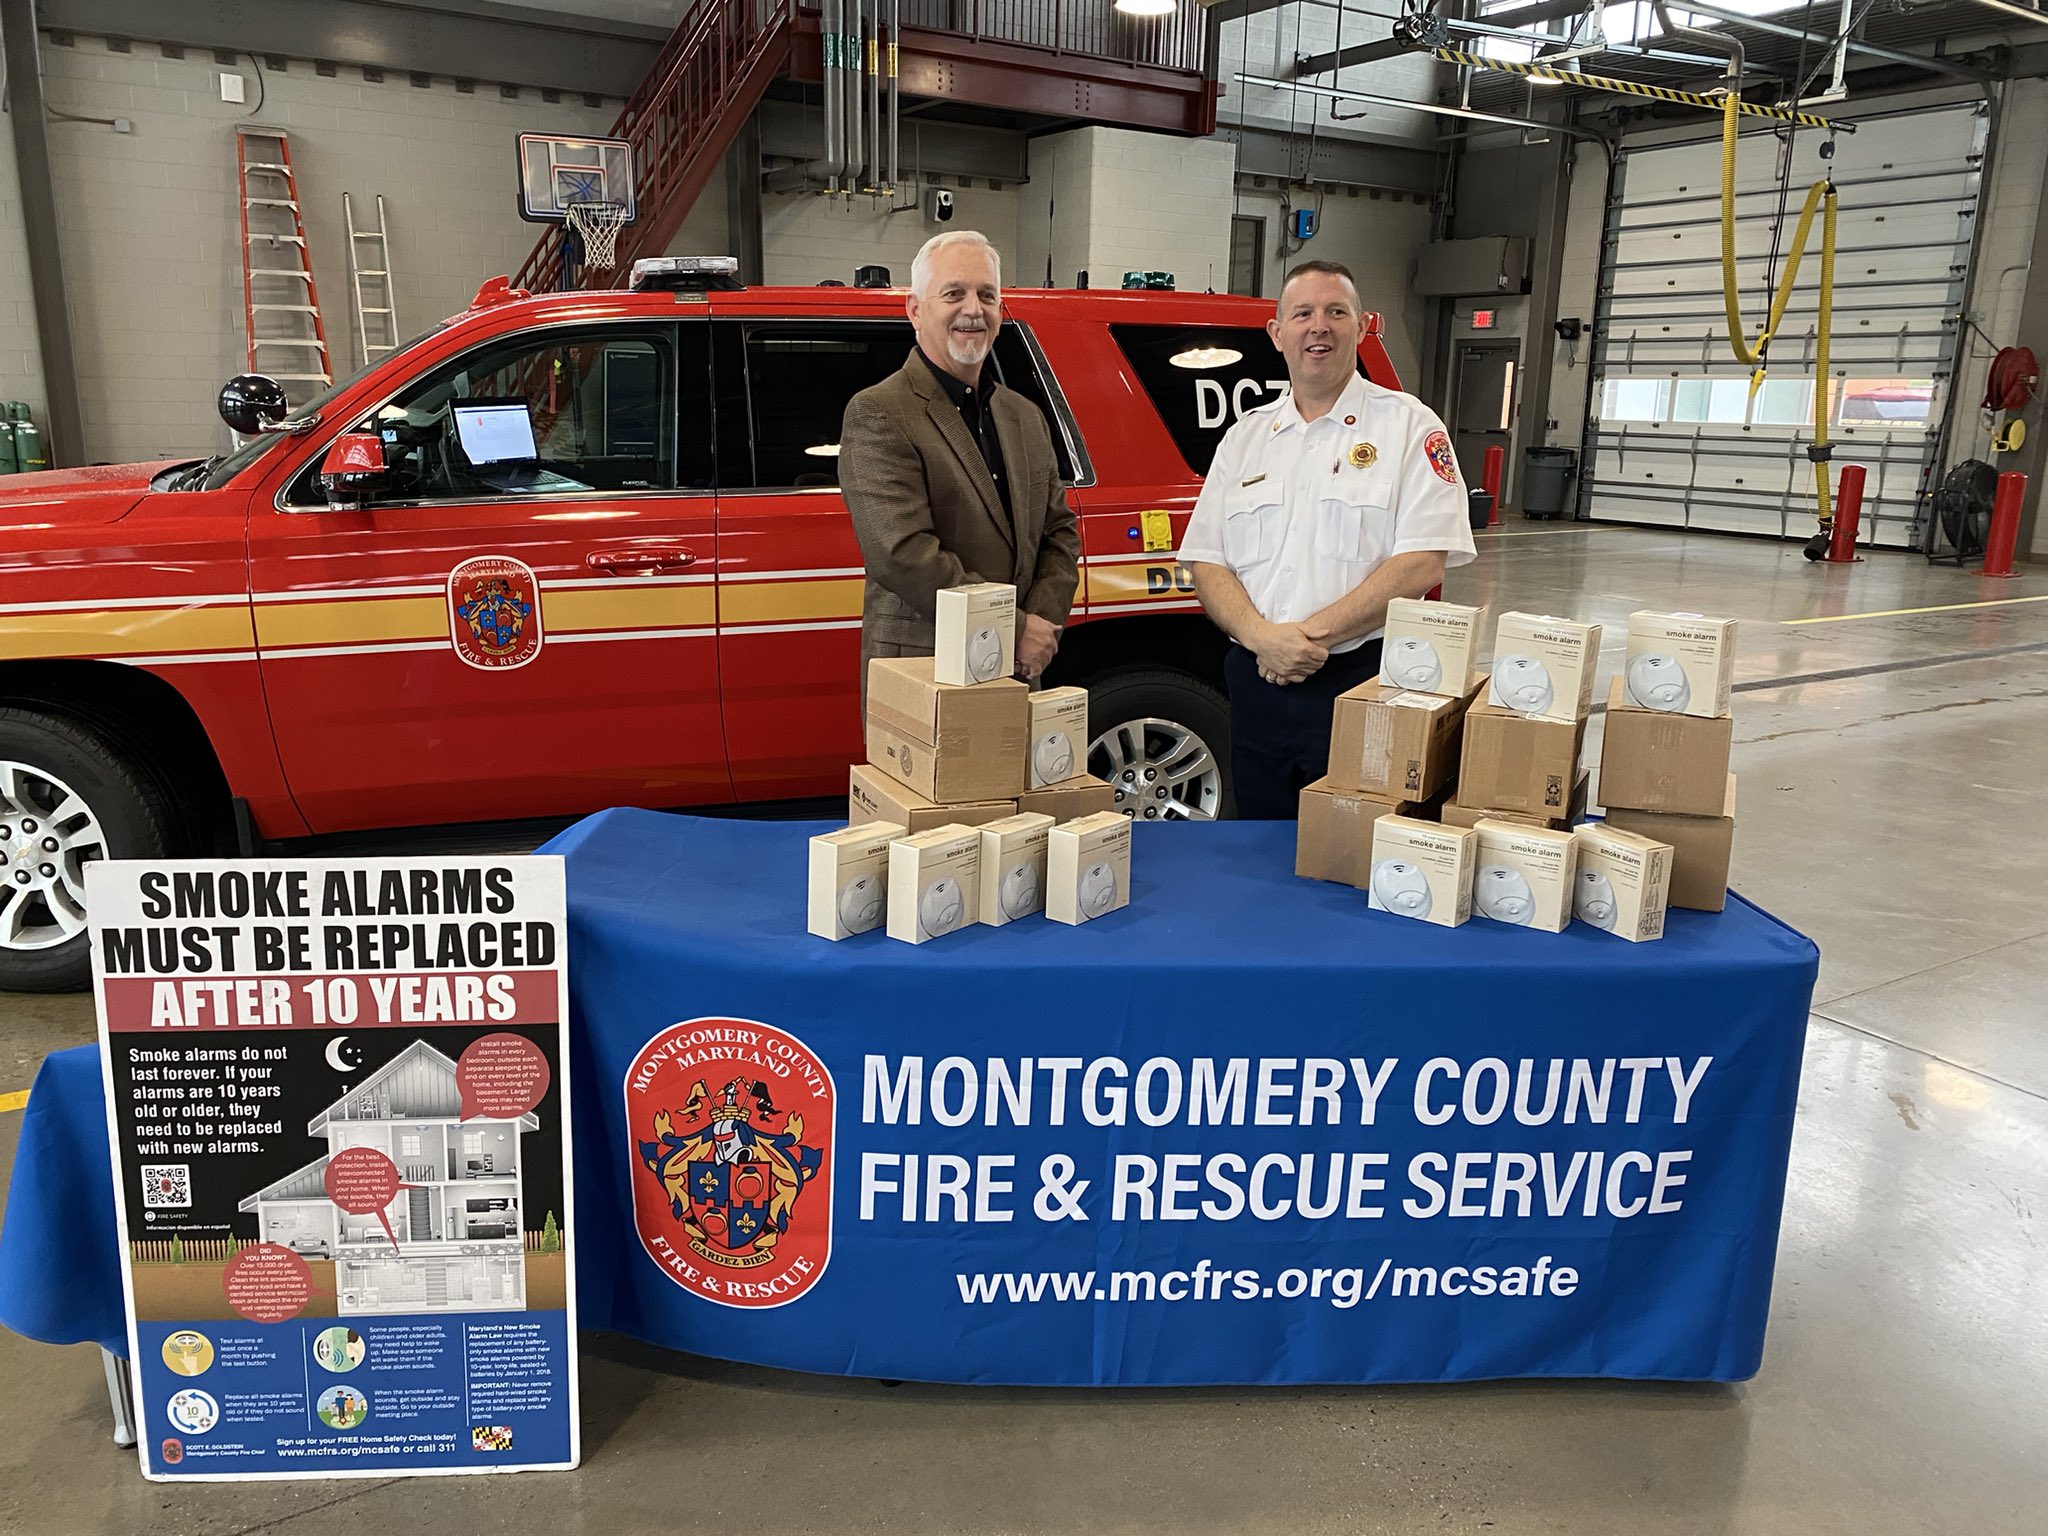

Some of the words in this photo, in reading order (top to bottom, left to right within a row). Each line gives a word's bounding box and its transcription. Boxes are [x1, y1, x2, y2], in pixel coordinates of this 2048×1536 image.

[453, 561, 502, 587] MONTGOMERY
[504, 562, 531, 584] COUNTY
[468, 569, 515, 580] MARYLAND
[1560, 637, 1581, 645] alarm
[459, 642, 481, 663] FIRE
[485, 658, 494, 666] &
[500, 639, 537, 665] RESCUE
[1057, 706, 1072, 714] smoke
[1103, 835, 1117, 843] smoke
[1409, 839, 1433, 847] smoke
[1435, 844, 1456, 852] alarm
[868, 846, 886, 855] smoke
[947, 849, 963, 858] smoke
[965, 844, 978, 853] alarm
[1511, 845, 1537, 854] smoke
[1539, 850, 1561, 858] alarm
[1600, 848, 1621, 859] smoke
[1622, 856, 1640, 865] alarm
[139, 871, 310, 920] SMOKE
[321, 868, 514, 916] ALARMS
[101, 927, 240, 973] MUST
[254, 926, 311, 970] BE
[323, 921, 555, 970] REPLACED
[151, 980, 293, 1027] AFTER
[303, 978, 357, 1024] 10
[368, 975, 516, 1022] YEARS
[129, 1048, 180, 1062] Smoke
[185, 1047, 236, 1061] alarms
[242, 1047, 259, 1060] do
[264, 1047, 287, 1060] not
[633, 1028, 763, 1094] MONTGOMERY
[766, 1039, 828, 1100] COUNTY
[676, 1046, 791, 1079] MARYLAND
[132, 1067, 159, 1080] last
[163, 1066, 220, 1080] forever.
[225, 1066, 235, 1079] If
[240, 1067, 272, 1081] your
[133, 1086, 184, 1099] alarms
[189, 1088, 213, 1098] are
[218, 1085, 236, 1097] 10
[241, 1085, 280, 1099] years
[862, 1054, 1399, 1127] MONTGOMERY
[1413, 1056, 1713, 1126] COUNTY
[135, 1104, 157, 1117] old
[162, 1106, 177, 1117] or
[182, 1103, 224, 1118] older,
[229, 1103, 261, 1118] they
[137, 1123, 171, 1136] need
[177, 1124, 190, 1135] to
[196, 1122, 213, 1135] be
[218, 1120, 282, 1135] replaced
[138, 1141, 168, 1154] with
[174, 1143, 203, 1154] new
[208, 1140, 264, 1153] alarms.
[859, 1152, 1015, 1223] FIRE
[1033, 1154, 1090, 1221] &
[1111, 1152, 1389, 1221] RESCUE
[1401, 1150, 1693, 1219] SERVICE
[691, 1243, 740, 1266] GARDEZ
[742, 1252, 771, 1266] BIEN
[650, 1235, 701, 1283] FIRE
[702, 1277, 721, 1293] &
[726, 1255, 815, 1299] RESCUE
[956, 1256, 1579, 1309] www.mcfrs.org/mcsafe
[187, 1407, 198, 1416] 10
[276, 1438, 293, 1447] Sign
[318, 1438, 336, 1446] your
[384, 1434, 407, 1443] Safety
[433, 1433, 457, 1441] today!
[278, 1444, 400, 1457] www.mcfrs.org/mcsafe
[403, 1445, 415, 1453] or
[417, 1443, 436, 1453] call
[438, 1443, 456, 1452] 311
